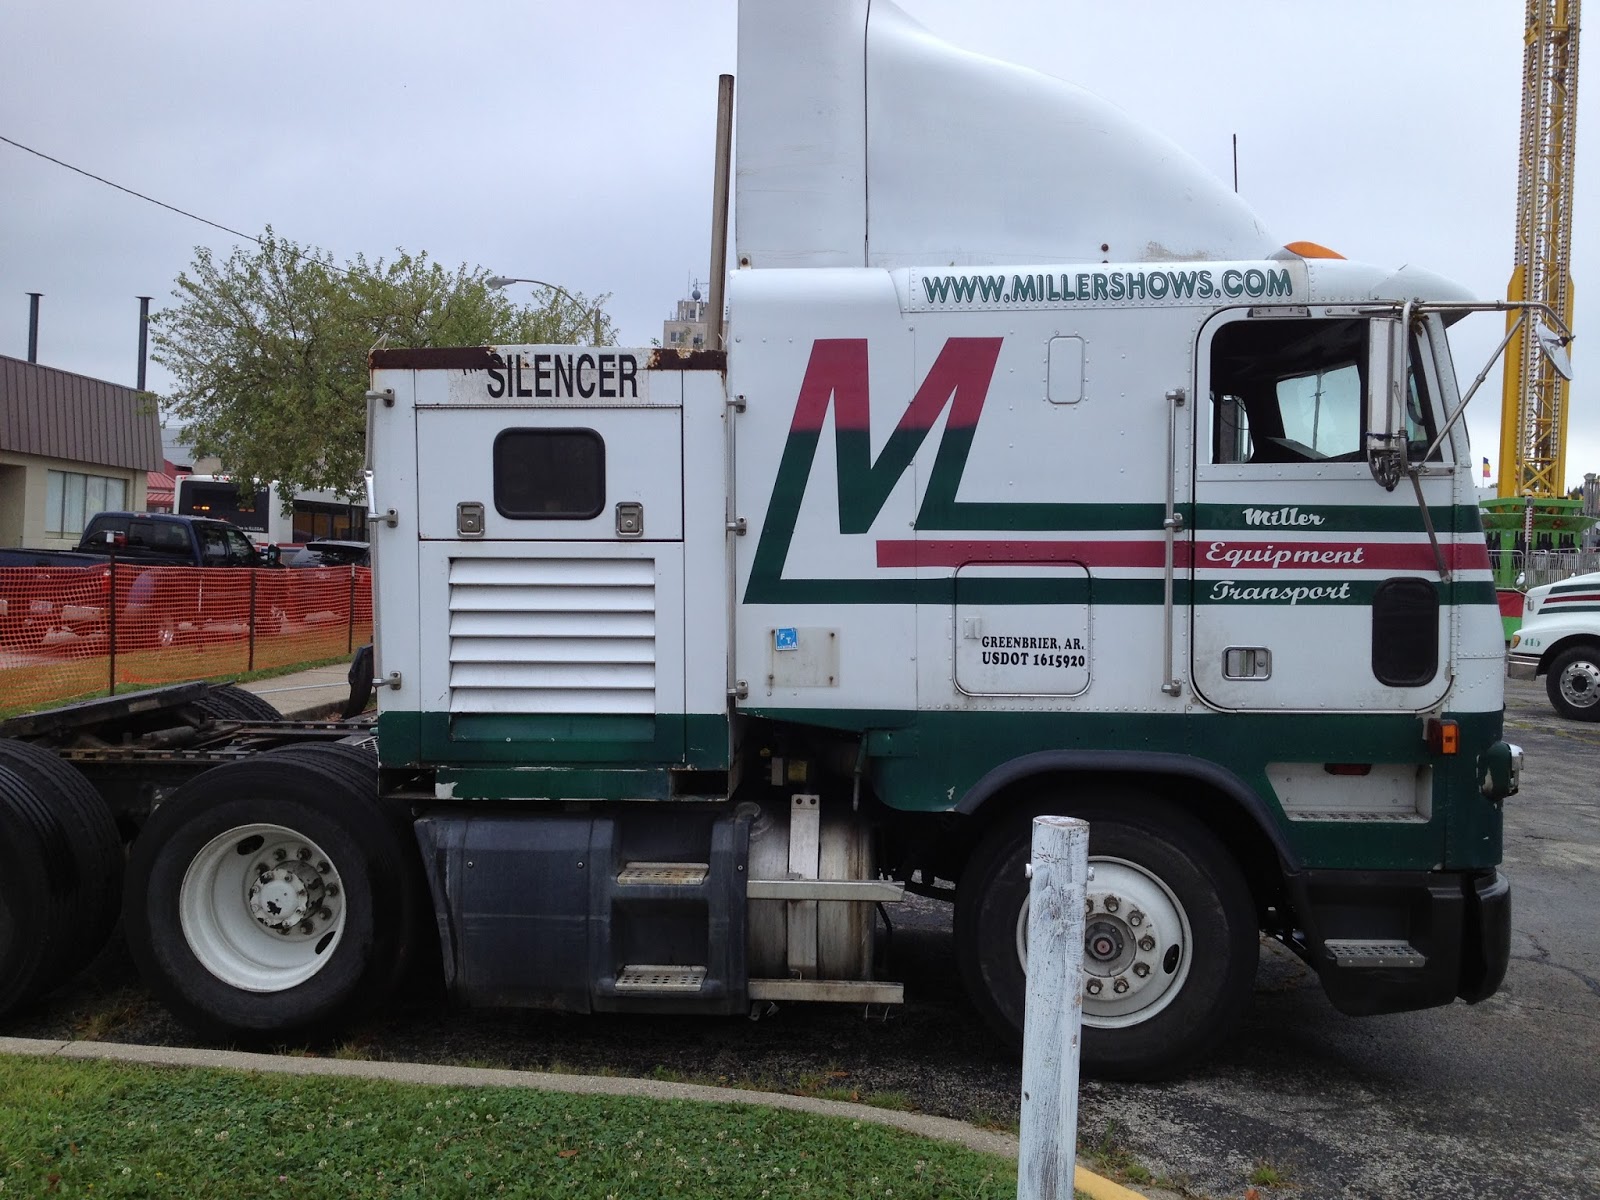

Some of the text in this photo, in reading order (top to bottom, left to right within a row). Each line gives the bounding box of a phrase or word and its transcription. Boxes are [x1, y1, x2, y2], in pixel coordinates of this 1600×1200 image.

[921, 268, 1293, 303] WWW.MILLERSHOWS.COM
[487, 353, 638, 399] SILENCER
[1242, 507, 1326, 526] Miller
[1205, 541, 1365, 569] Equipment
[1209, 580, 1351, 606] Transport
[981, 635, 1085, 652] GREENBRIER, AR.
[981, 651, 1085, 669] USDOT 1615920
